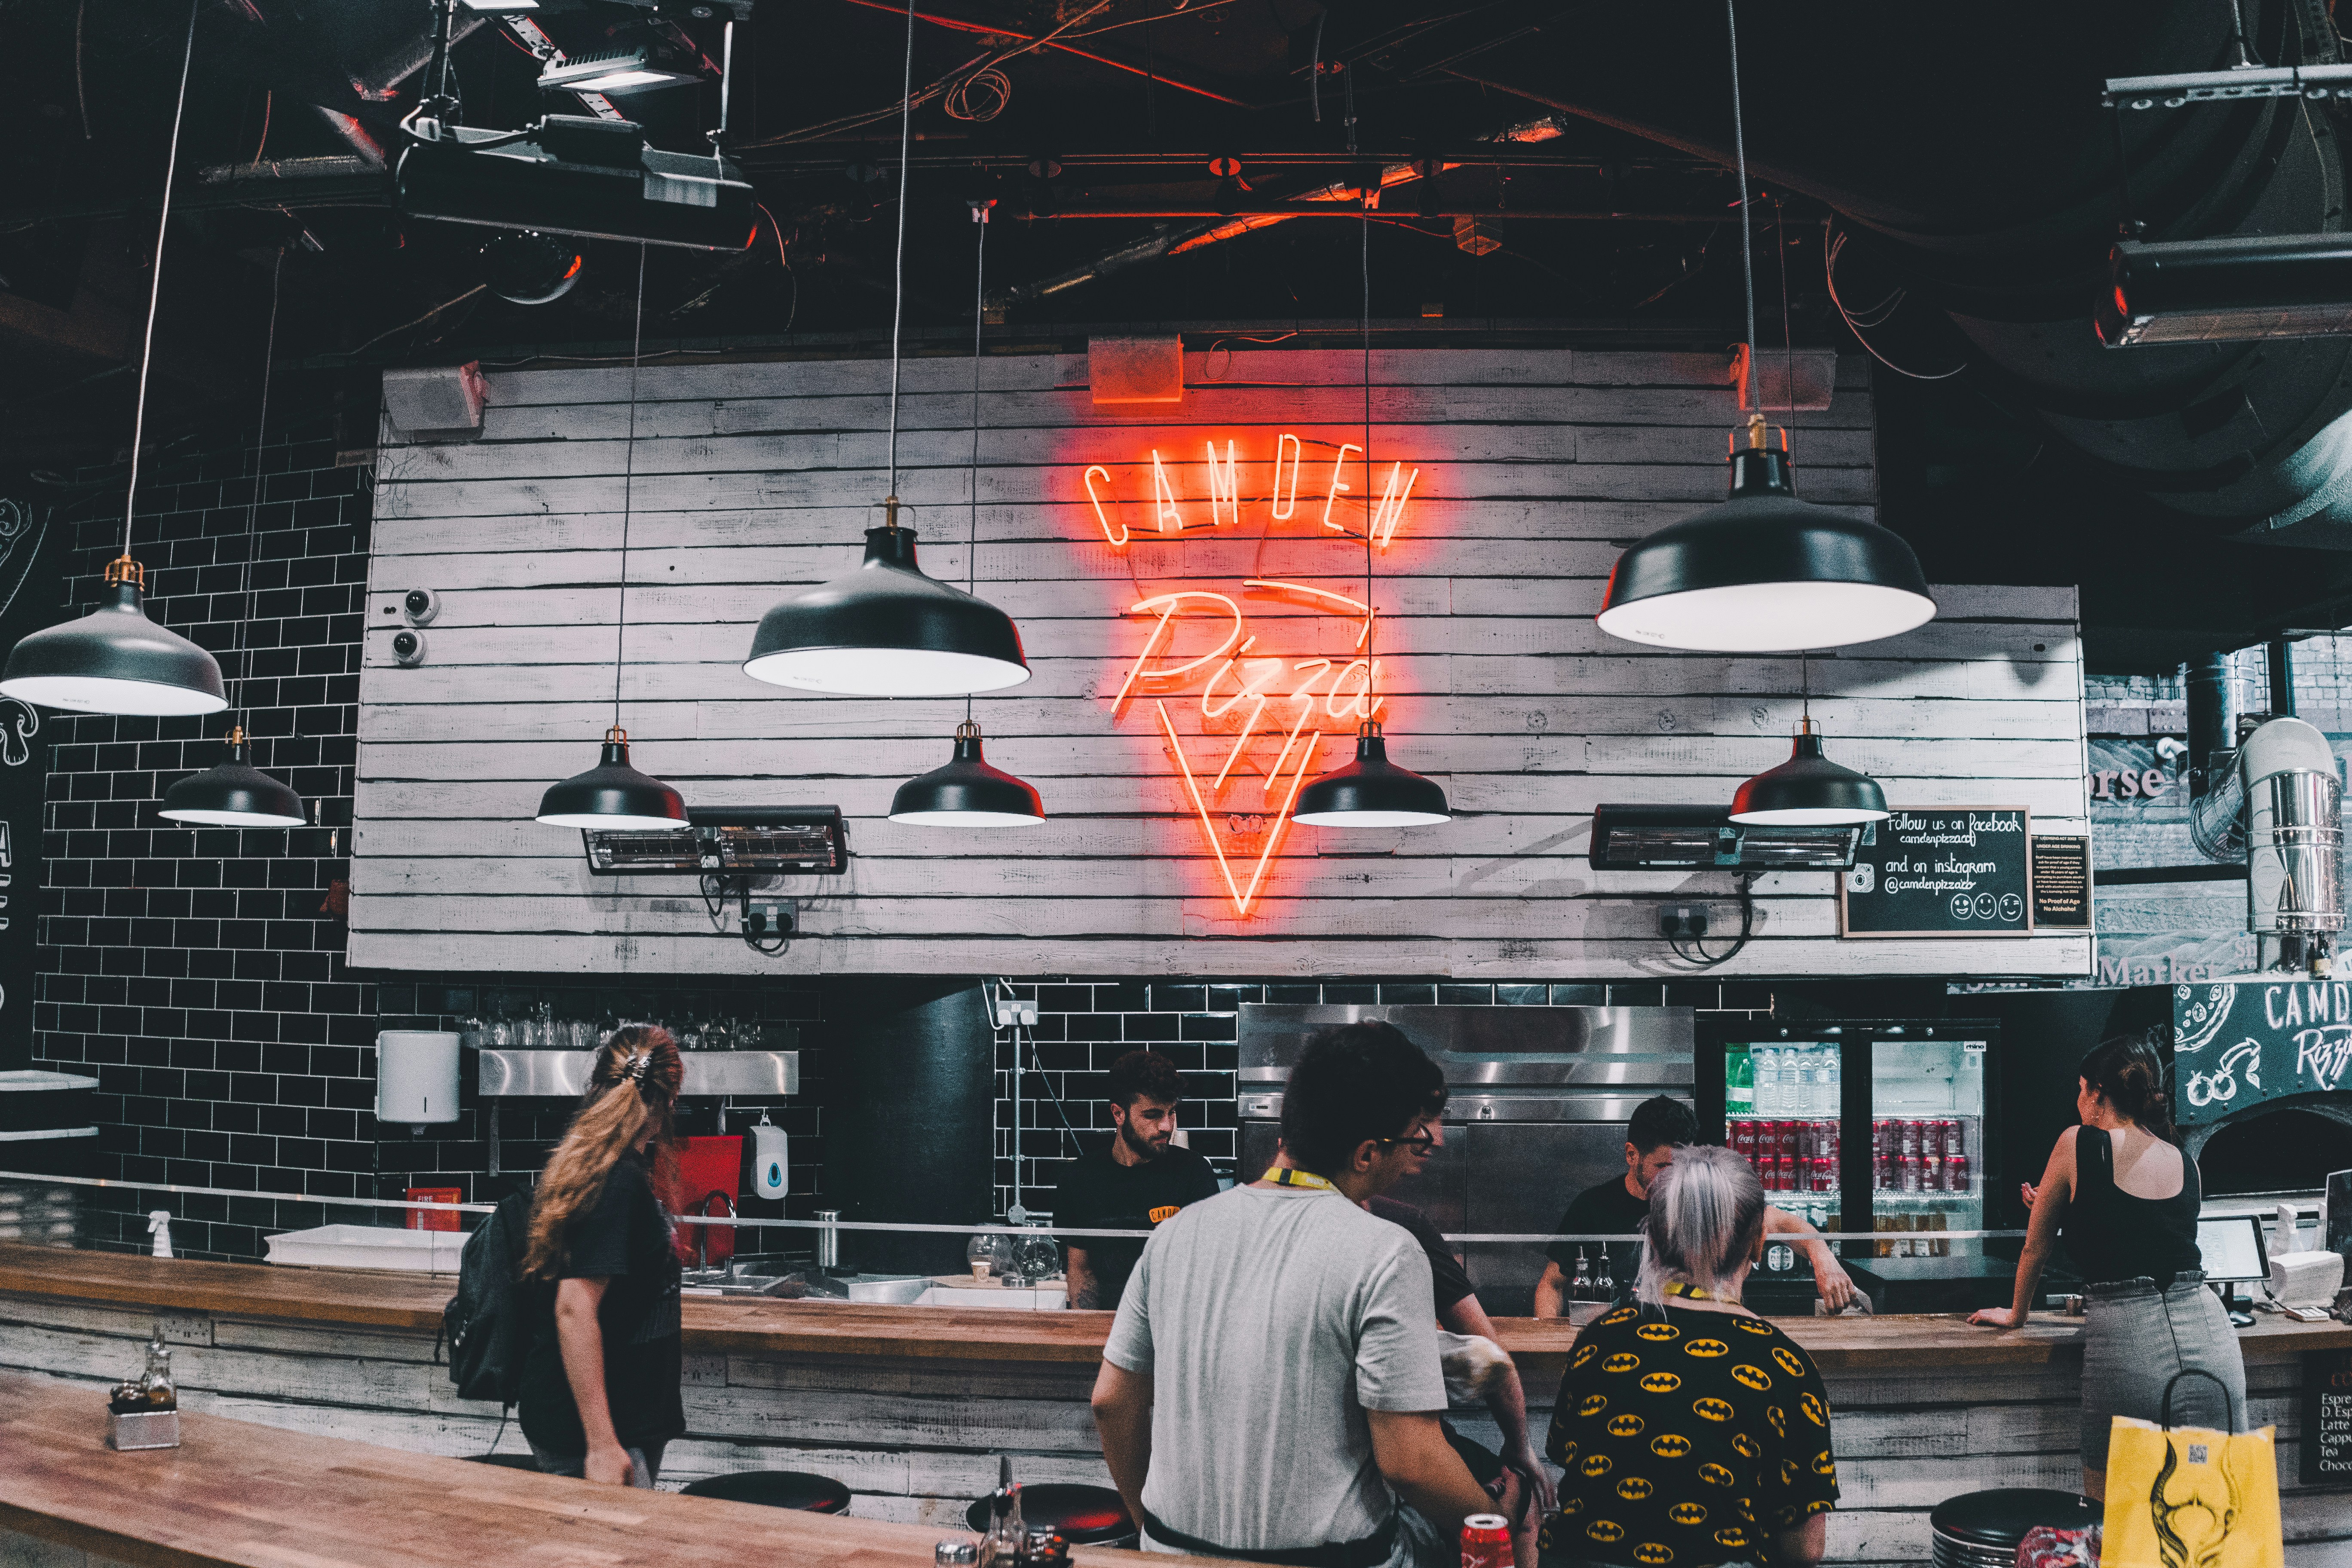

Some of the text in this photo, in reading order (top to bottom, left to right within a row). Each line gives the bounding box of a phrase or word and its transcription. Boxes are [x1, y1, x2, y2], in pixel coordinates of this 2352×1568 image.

[1084, 434, 1418, 547] CAMDEN
[1111, 591, 1384, 790] Pizza
[1887, 812, 2022, 847] Follow us on facebook
[1886, 852, 1996, 882] and on instagram
[2265, 983, 2350, 1029] CAMD
[2321, 1419, 2350, 1430] Latte
[2319, 1446, 2338, 1457] Tea
